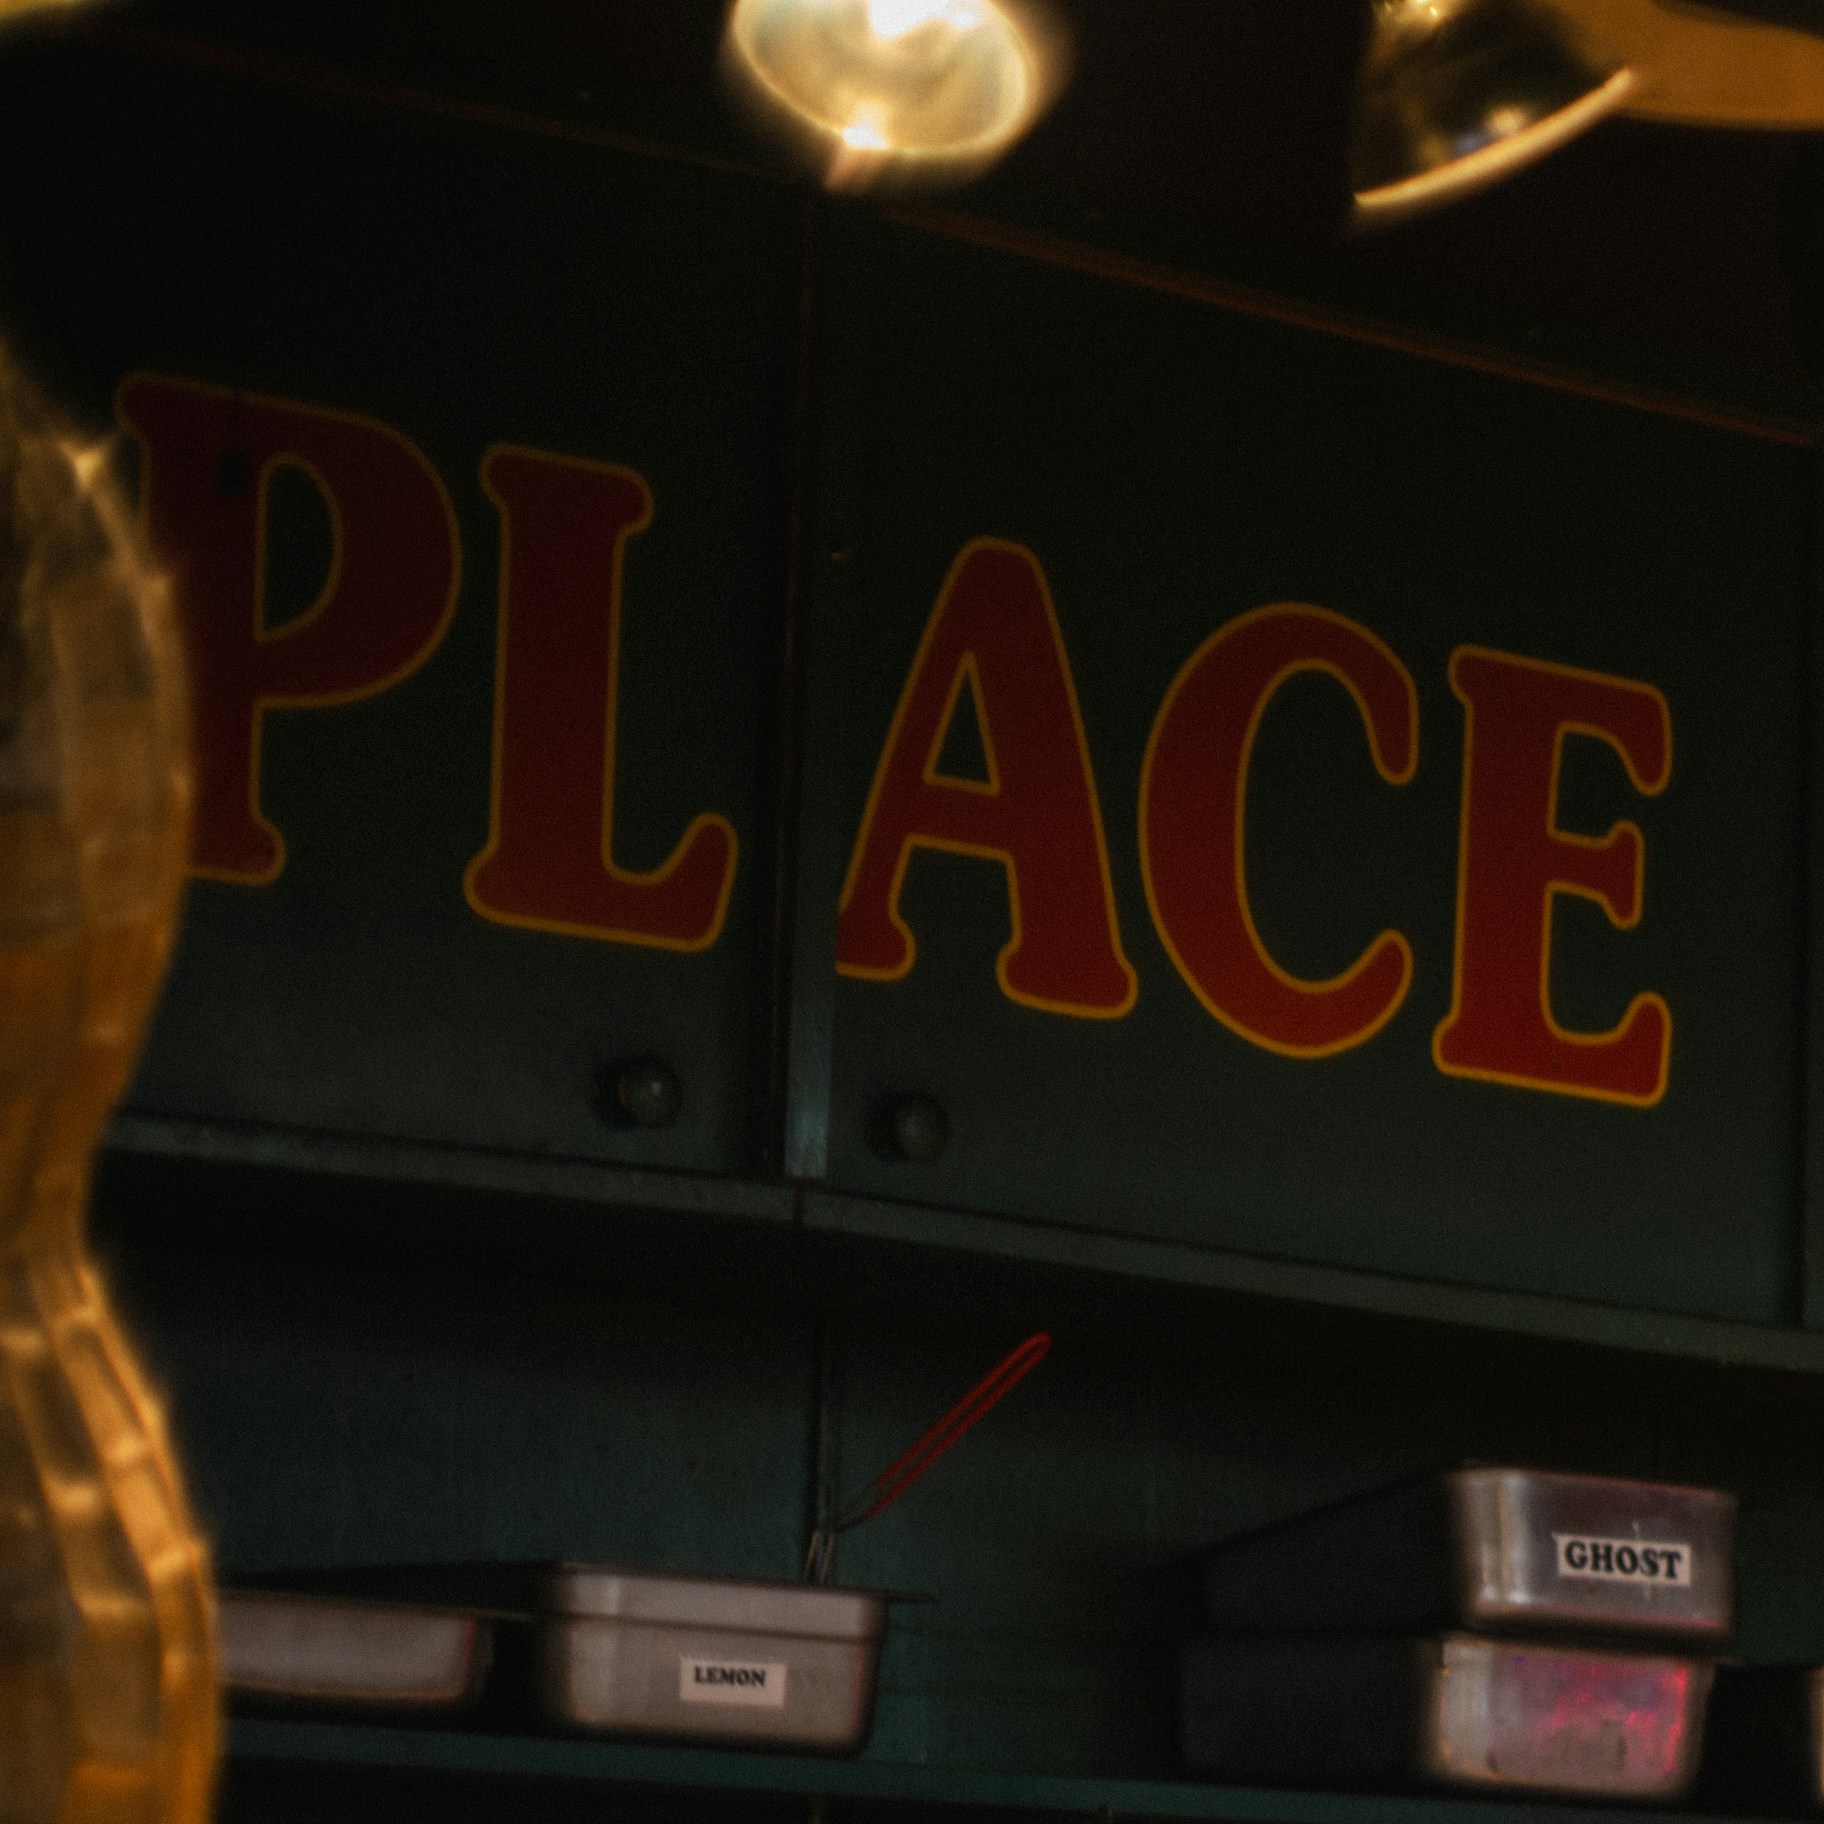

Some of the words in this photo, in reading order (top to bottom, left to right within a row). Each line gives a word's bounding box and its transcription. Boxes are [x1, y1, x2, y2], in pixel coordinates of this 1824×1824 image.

[115, 370, 1672, 1108] PLACE
[1564, 1534, 1683, 1580] GHOST
[694, 1666, 766, 1689] LEMON
